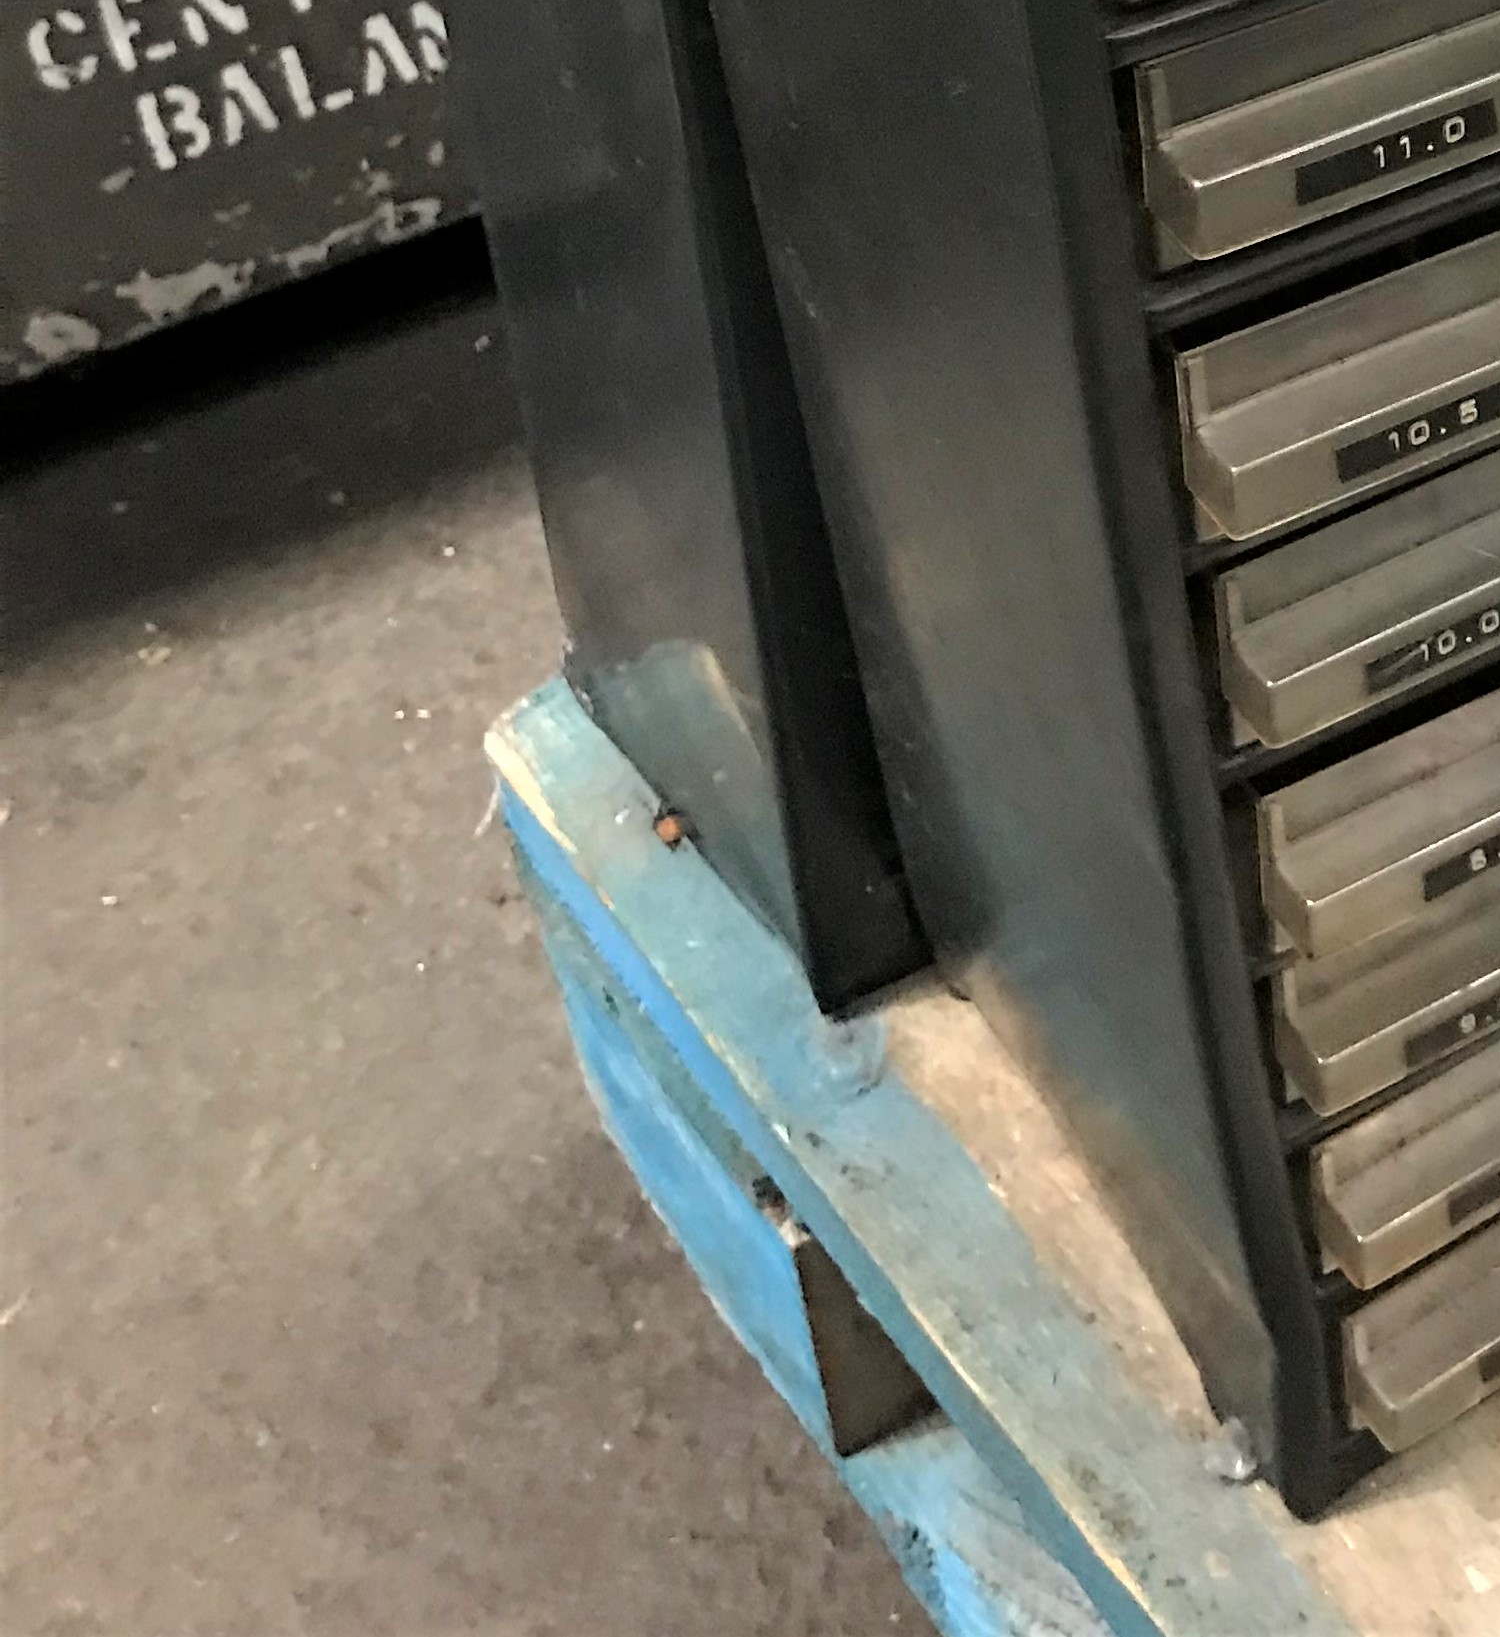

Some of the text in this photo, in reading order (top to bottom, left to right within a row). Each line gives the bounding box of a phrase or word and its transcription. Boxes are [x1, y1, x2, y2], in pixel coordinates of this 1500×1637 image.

[1372, 115, 1466, 168] 11.0
[1388, 398, 1478, 451] 10.5
[1420, 609, 1500, 661] 10.0
